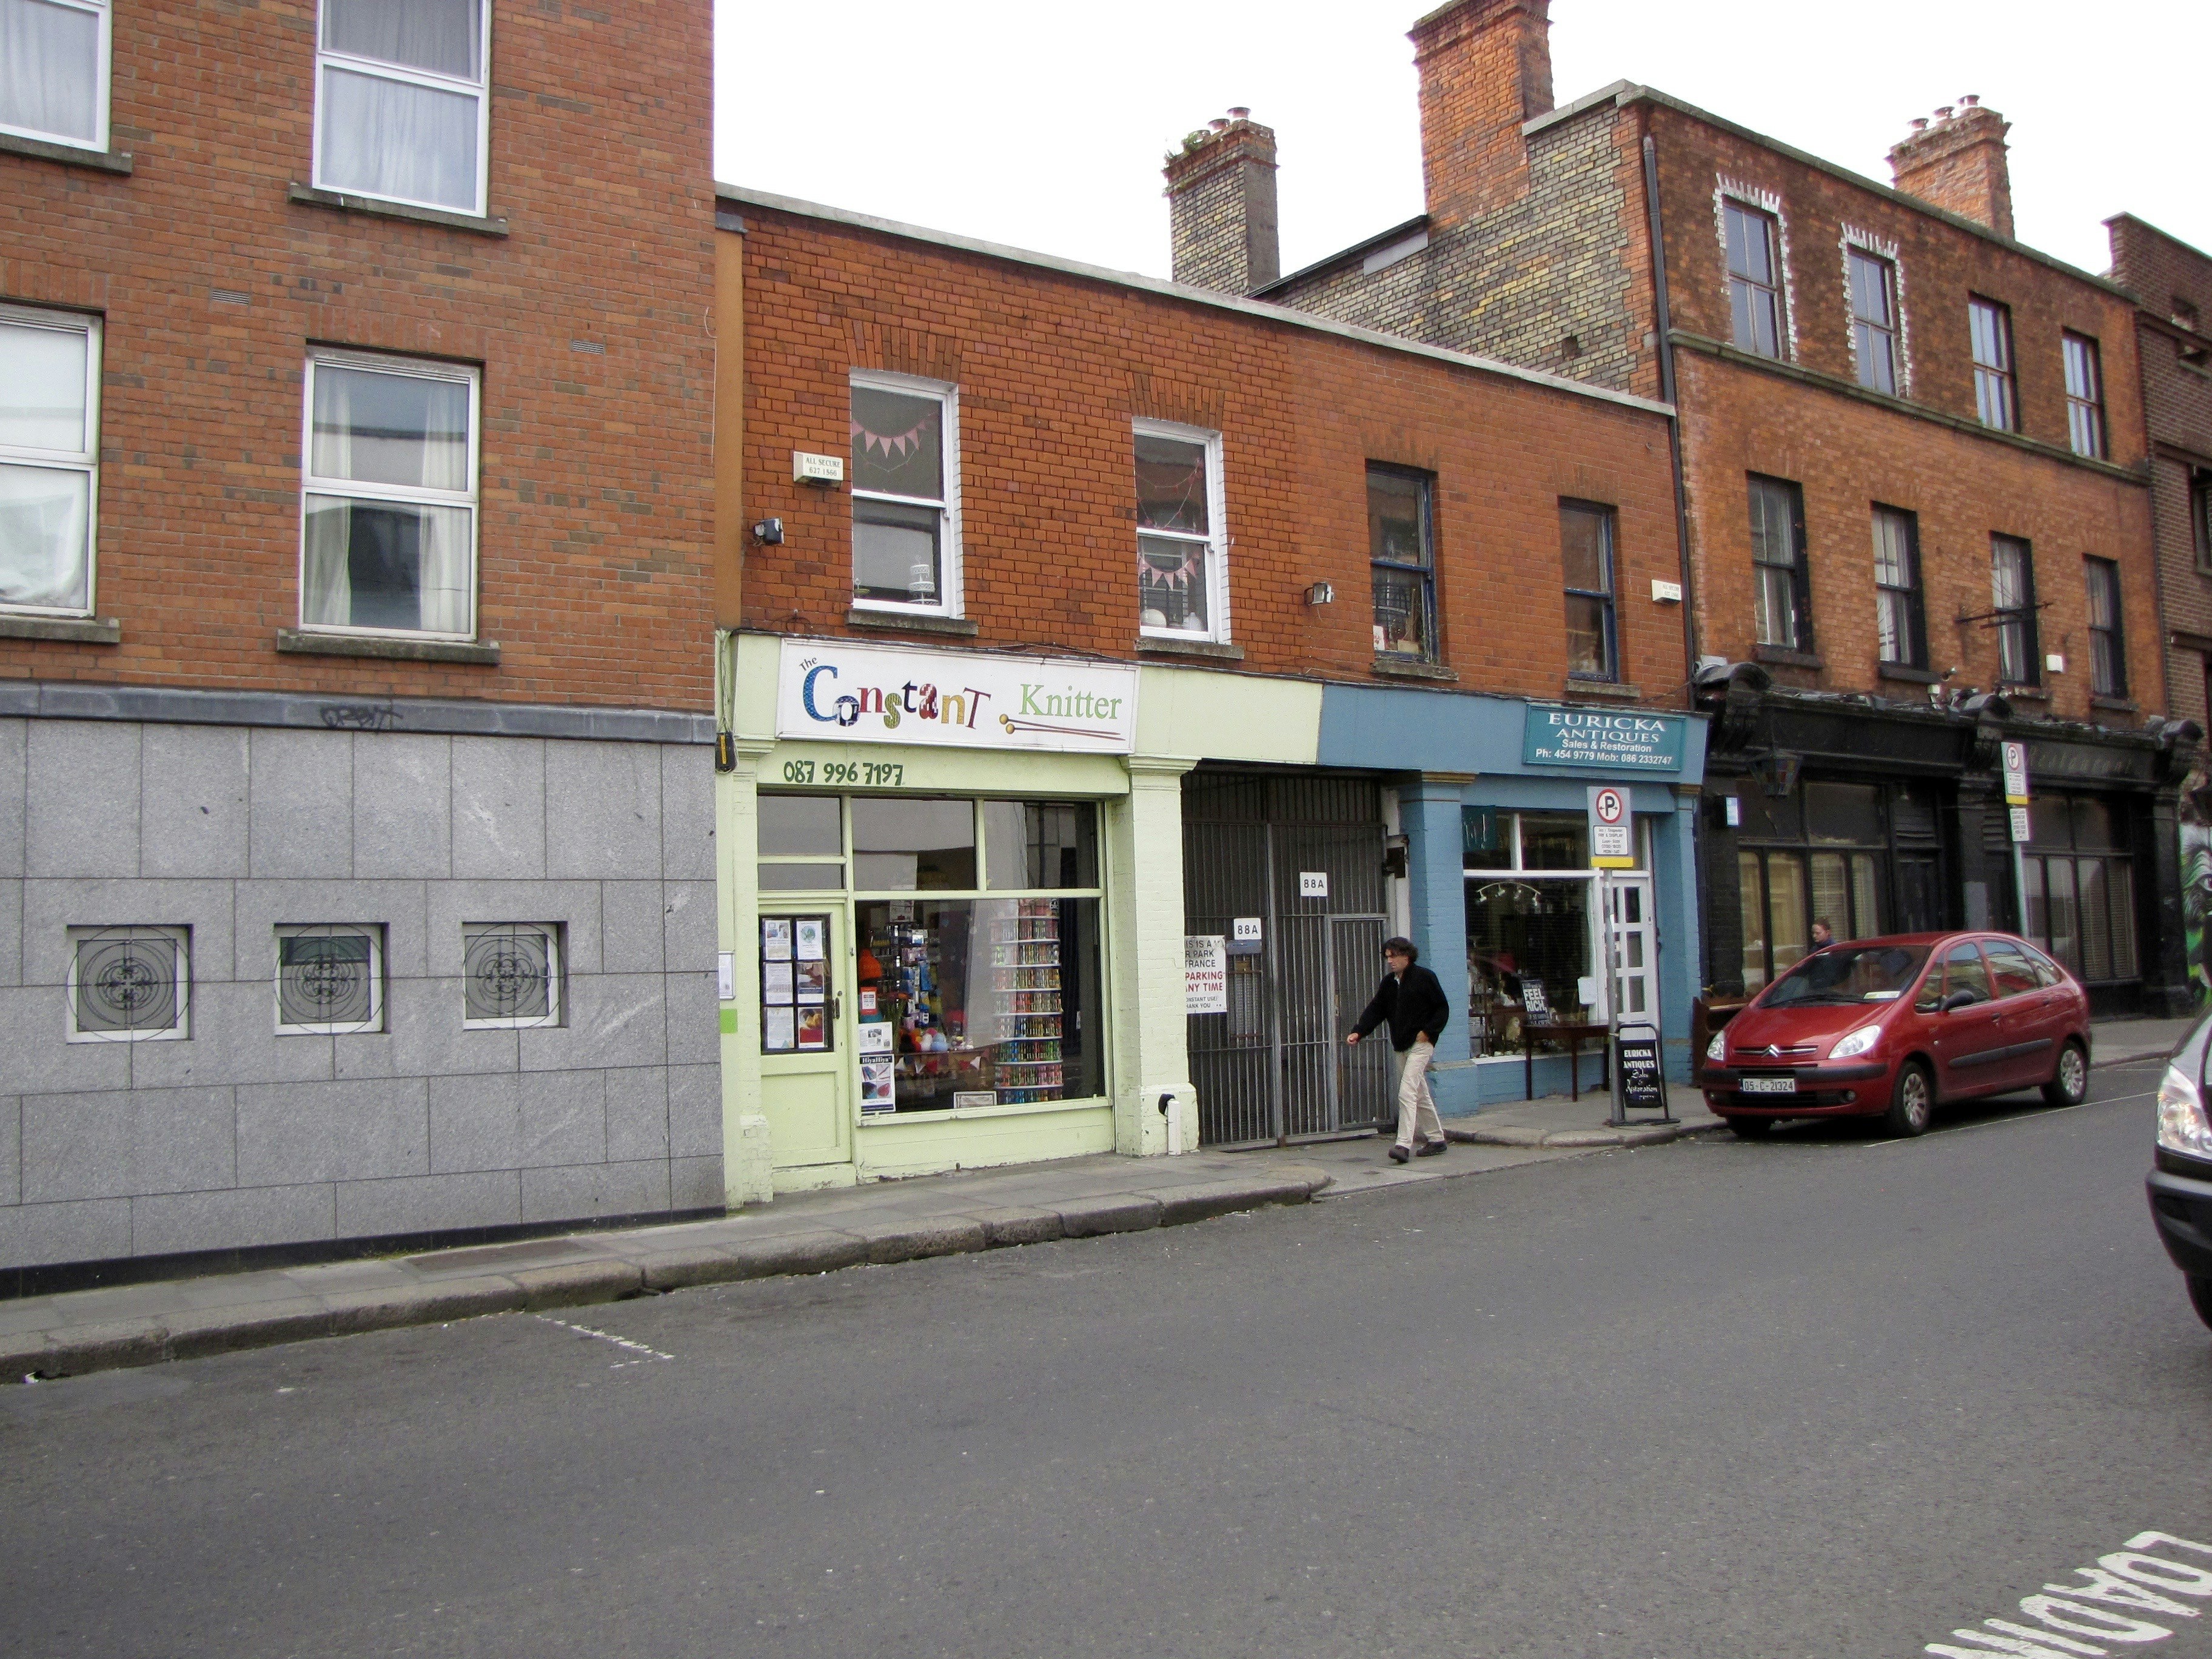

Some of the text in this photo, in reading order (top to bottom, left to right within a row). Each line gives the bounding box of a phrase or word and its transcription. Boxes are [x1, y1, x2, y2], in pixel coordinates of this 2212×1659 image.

[819, 458, 840, 468] SECURE
[799, 657, 818, 671] The
[1019, 683, 1122, 720] Knitter
[1549, 712, 1666, 732] EURICKA
[1555, 728, 1660, 743] ANTIQUES
[1562, 739, 1652, 752] Sales & Restoration
[1535, 748, 1552, 757] Ph:
[1554, 749, 1571, 759] 454
[1573, 751, 1594, 760] 9779
[1597, 752, 1618, 762] Mob:
[1621, 754, 1637, 763] 086
[783, 760, 903, 786] 087 996 7197
[1303, 879, 1324, 889] 88A
[1237, 925, 1258, 934] 88A
[1207, 939, 1212, 948] A
[1193, 949, 1215, 957] PARK
[1185, 971, 1223, 981] PARKING
[1203, 982, 1223, 992] TIME
[1523, 988, 1545, 1002] FEEL
[1623, 1060, 1655, 1069] ANTIQUES
